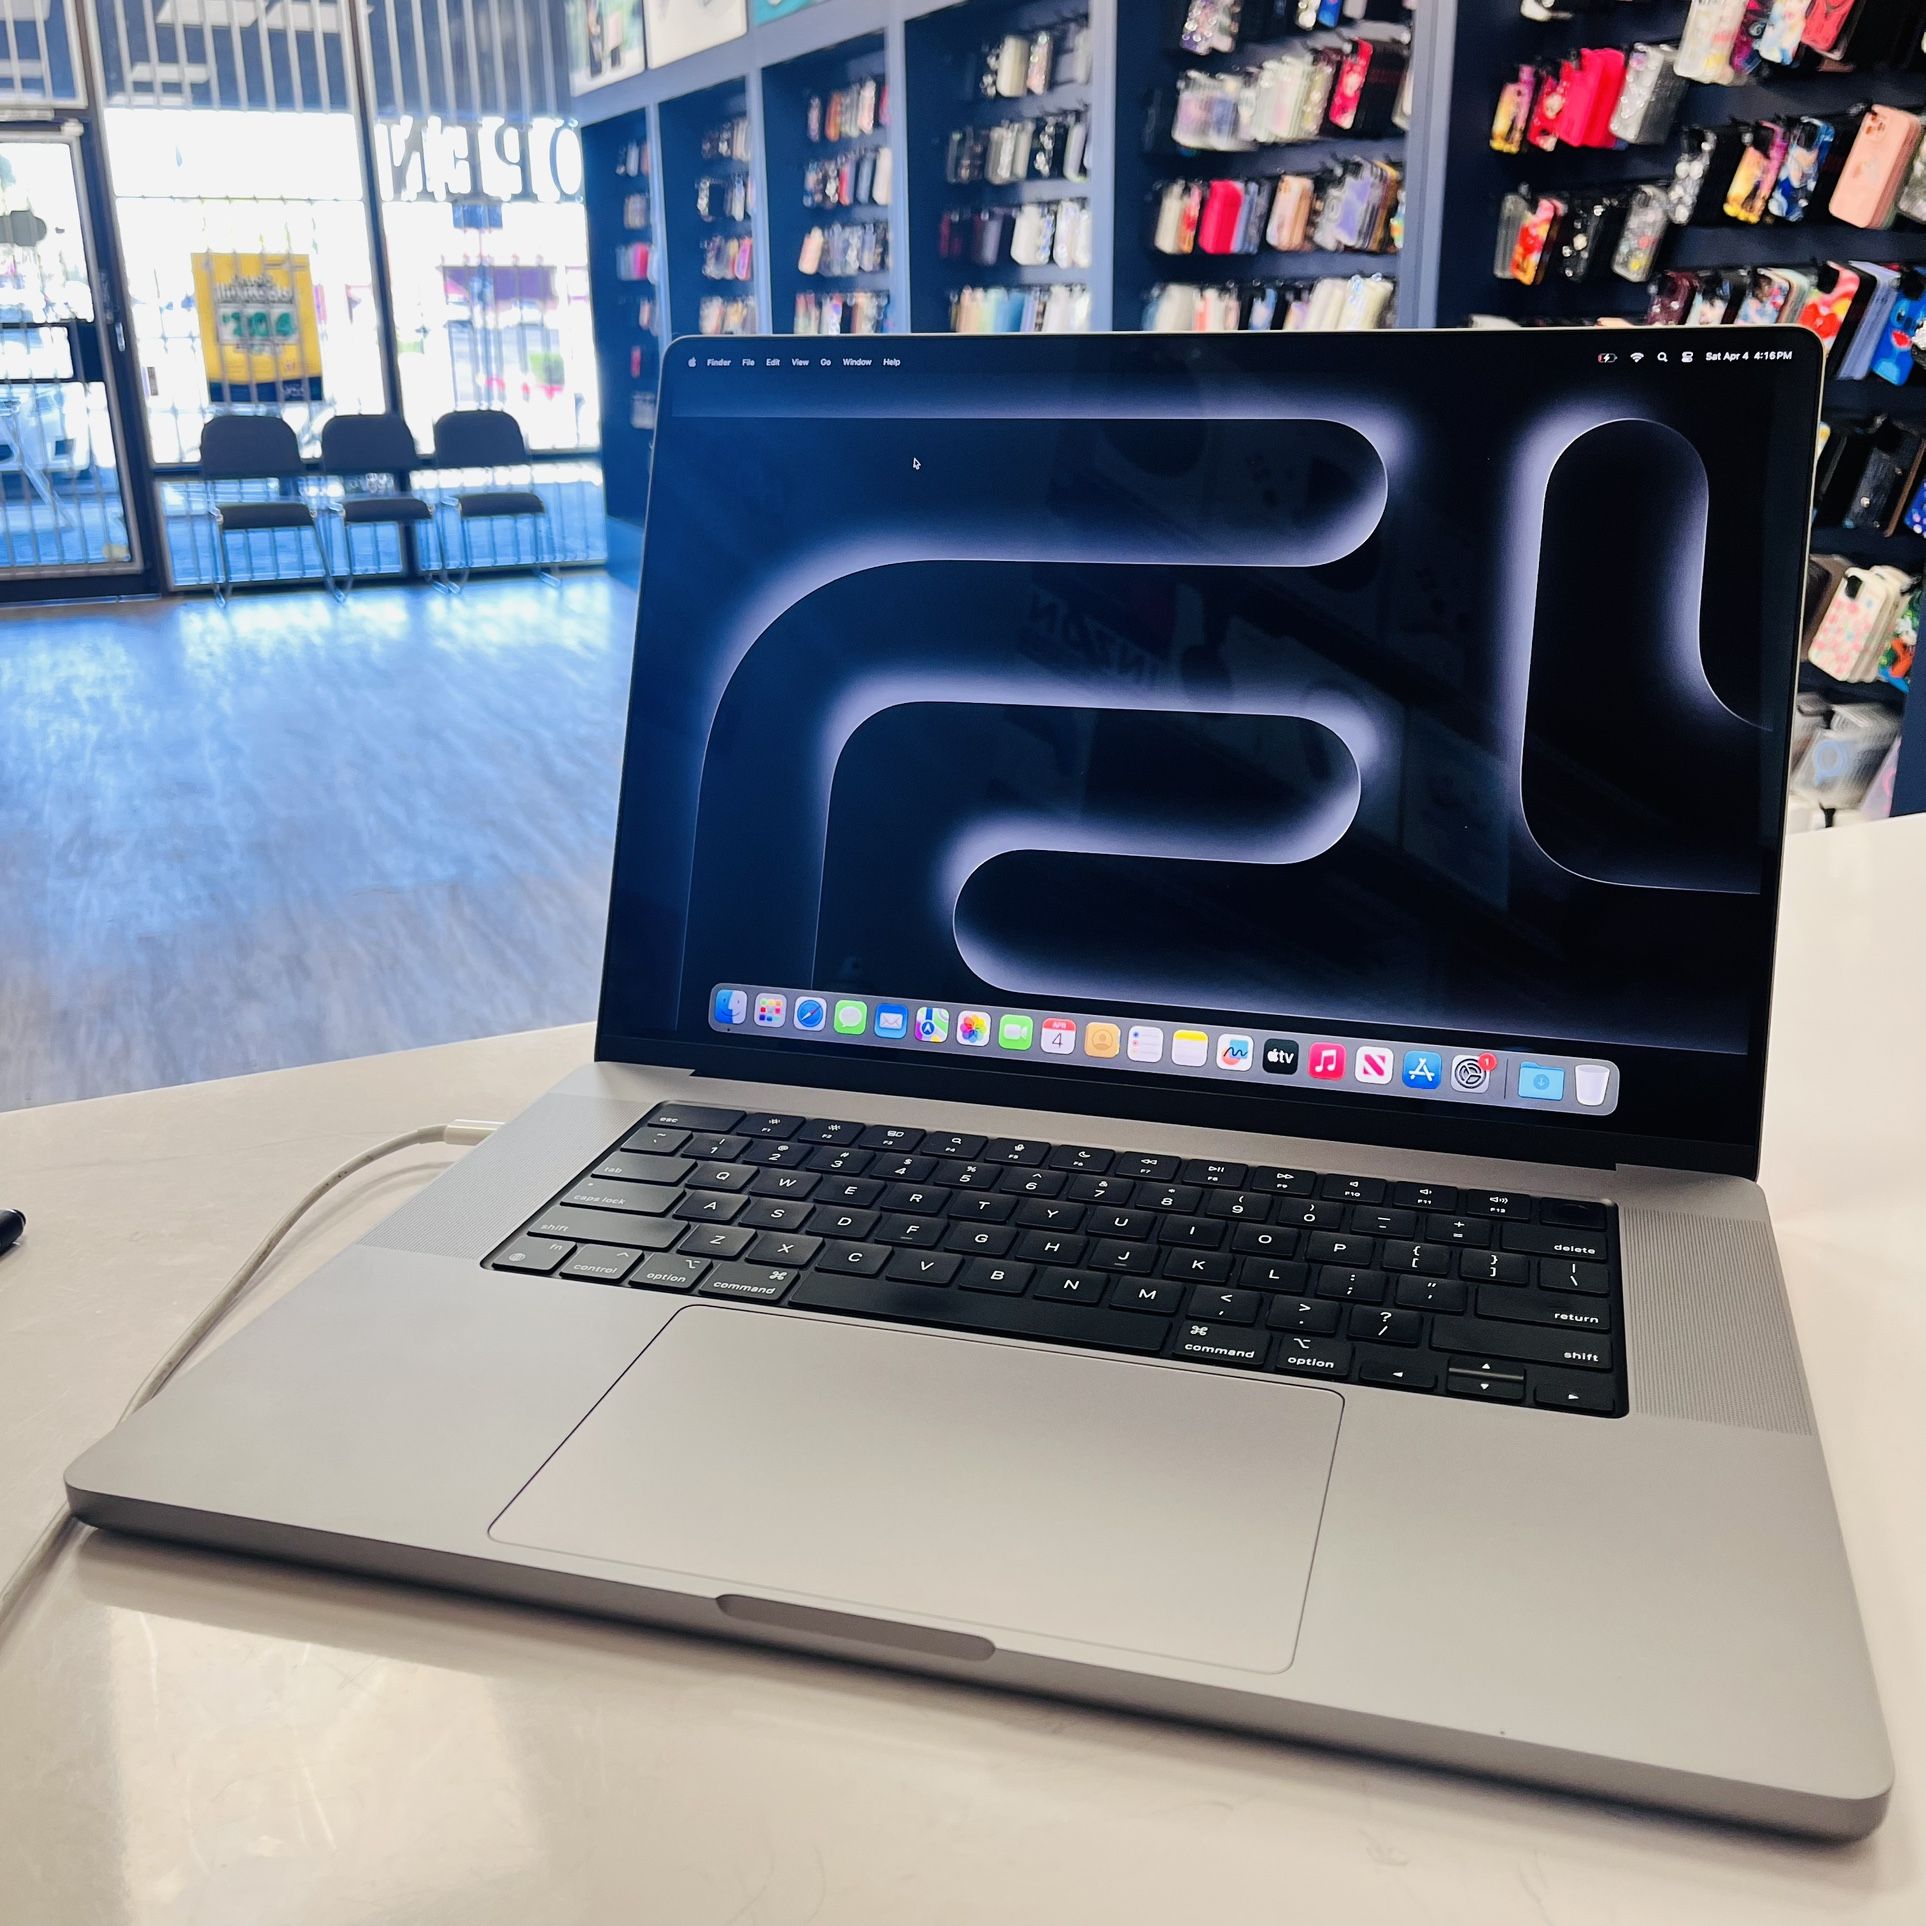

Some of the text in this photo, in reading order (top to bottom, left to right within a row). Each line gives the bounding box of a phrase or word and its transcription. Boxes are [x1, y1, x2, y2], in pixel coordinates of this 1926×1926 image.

[1706, 352, 1721, 361] Sat
[1723, 352, 1741, 361] Apr
[1742, 352, 1749, 360] 4
[843, 358, 872, 366] Window
[883, 358, 900, 366] Help
[1052, 1033, 1062, 1048] 4
[1278, 1051, 1294, 1064] tv
[602, 1167, 622, 1175] tab
[716, 1172, 729, 1180] Q
[845, 1186, 857, 1194] E
[574, 1194, 625, 1206] caps lock
[910, 1194, 922, 1202] R
[979, 1201, 990, 1209] T
[1232, 1205, 1243, 1213] 9
[1048, 1210, 1058, 1218] Y
[838, 1217, 851, 1225] D
[1115, 1218, 1128, 1226] U
[541, 1224, 568, 1234] shift
[710, 1235, 725, 1244] Z
[975, 1234, 988, 1242] G
[1259, 1235, 1272, 1243] O
[778, 1244, 794, 1253] X
[1045, 1243, 1060, 1251] H
[1334, 1244, 1346, 1252] P
[1413, 1246, 1420, 1256] {
[1554, 1245, 1595, 1254] delete
[849, 1253, 862, 1261] C
[1118, 1252, 1129, 1260] J
[1491, 1255, 1497, 1264] }
[921, 1261, 934, 1270] V
[1192, 1260, 1205, 1269] K
[1412, 1258, 1418, 1267] [
[574, 1265, 617, 1275] control
[1269, 1270, 1279, 1279] L
[1490, 1267, 1496, 1276] ]
[647, 1273, 686, 1282] option
[991, 1271, 1004, 1280] B
[1064, 1280, 1079, 1289] N
[1571, 1276, 1577, 1286] \
[714, 1282, 775, 1294] command
[1139, 1289, 1156, 1299] M
[1381, 1312, 1391, 1322] ?
[1555, 1314, 1598, 1323] return
[1378, 1326, 1387, 1335] /
[1185, 1344, 1254, 1358] command
[1564, 1352, 1598, 1361] shift
[1288, 1357, 1334, 1368] option
